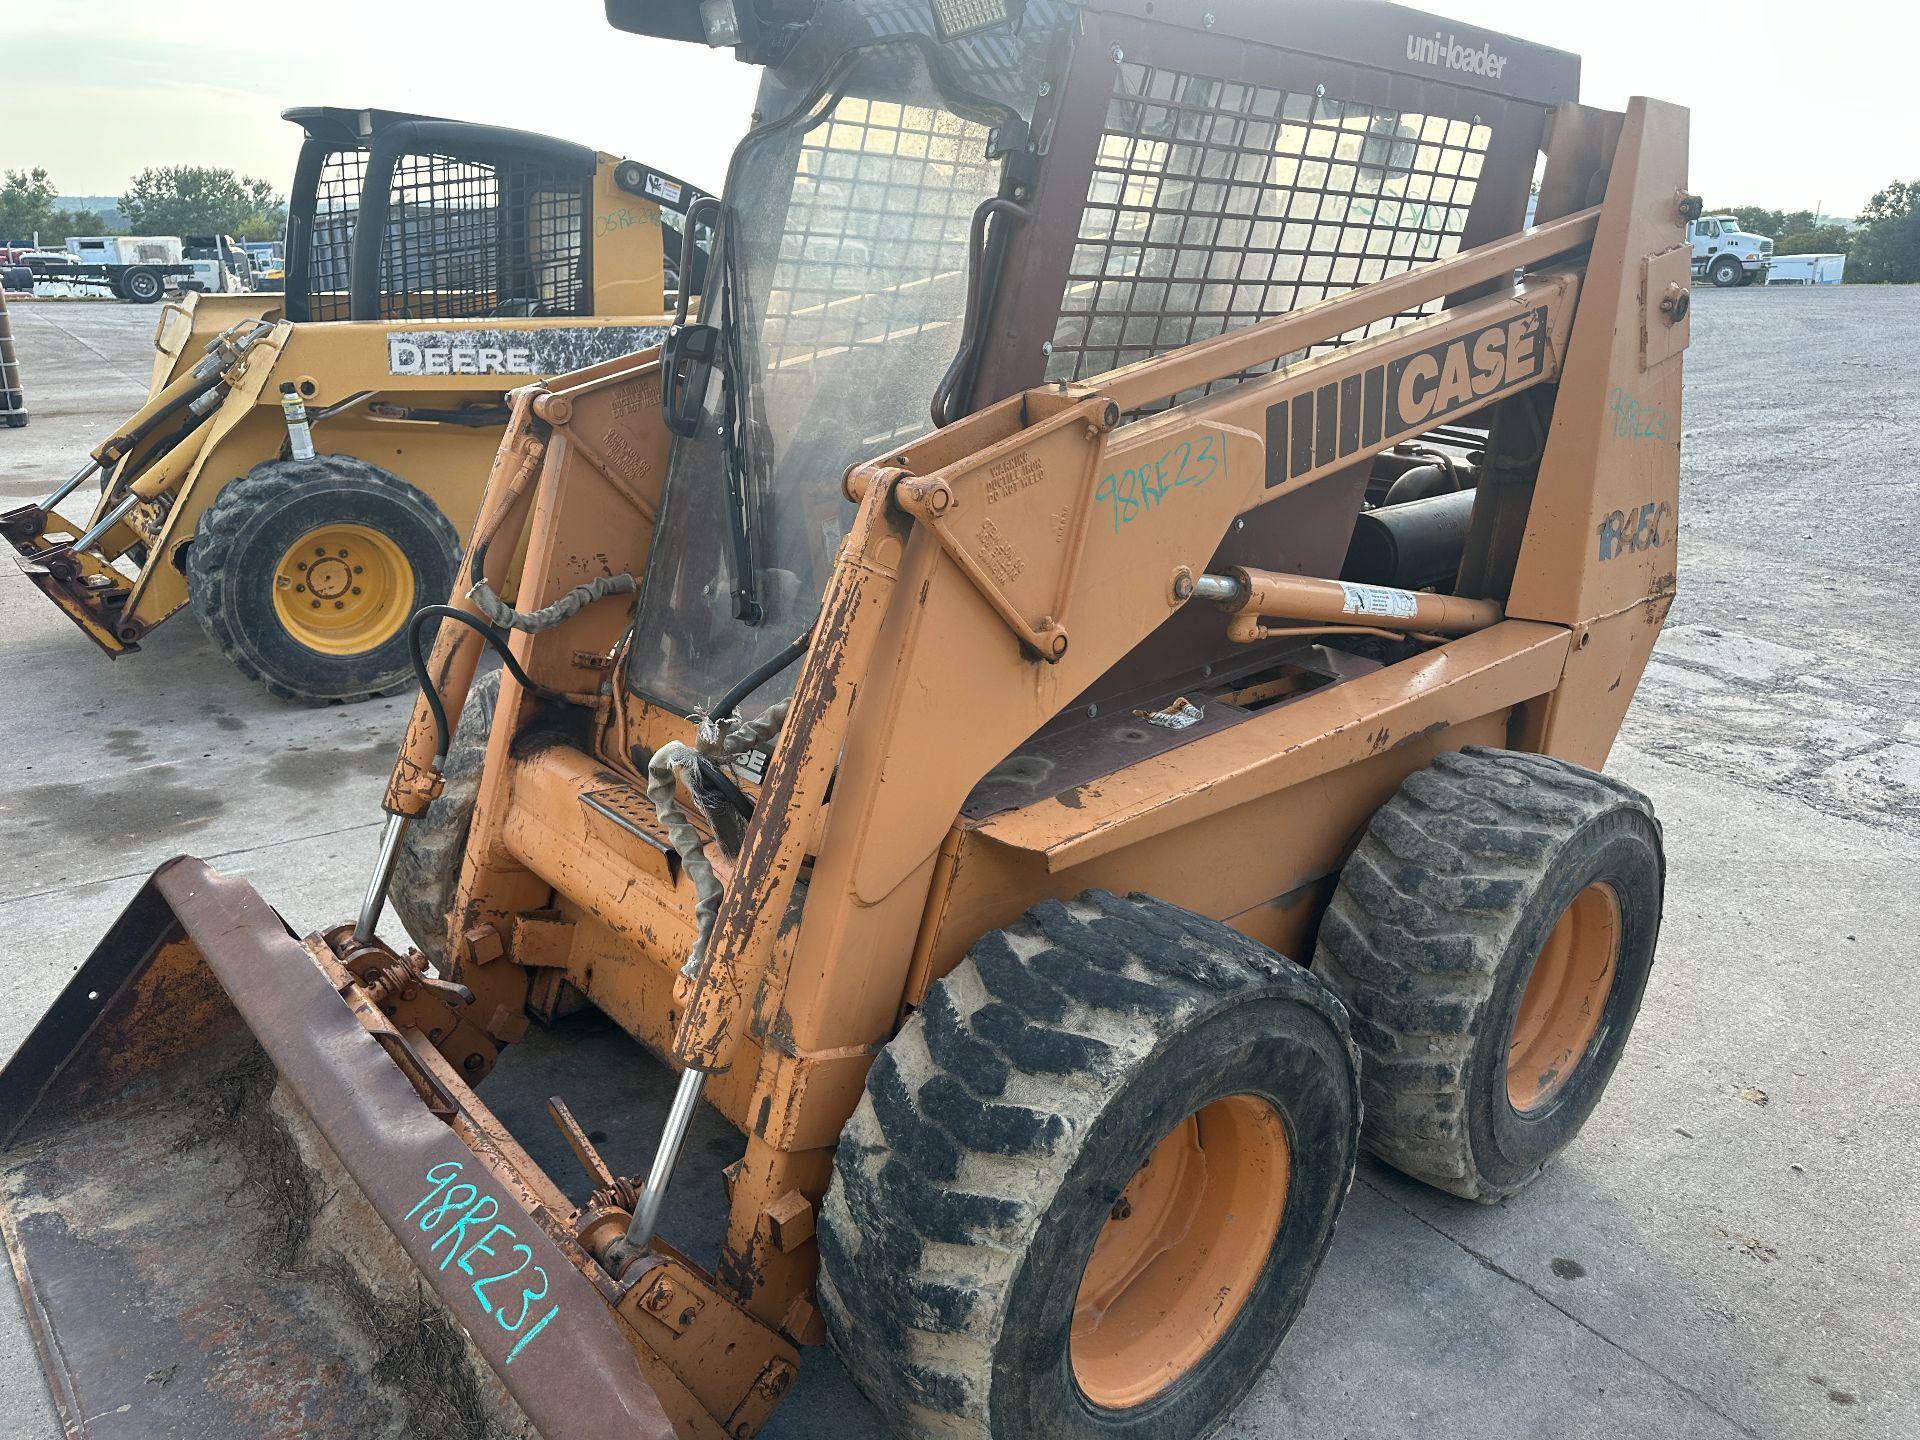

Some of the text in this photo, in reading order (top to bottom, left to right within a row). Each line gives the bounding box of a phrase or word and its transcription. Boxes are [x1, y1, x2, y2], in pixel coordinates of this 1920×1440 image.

[1406, 31, 1507, 79] uni-loader
[390, 340, 531, 374] DEERE
[1398, 313, 1540, 425] CASE
[985, 457, 1042, 494] DUCTILE IRON
[989, 451, 1029, 479] WARNING
[1095, 431, 1229, 537] 98RE231
[986, 470, 1045, 505] DO NOT WELD
[404, 1161, 559, 1365] 98RE231
